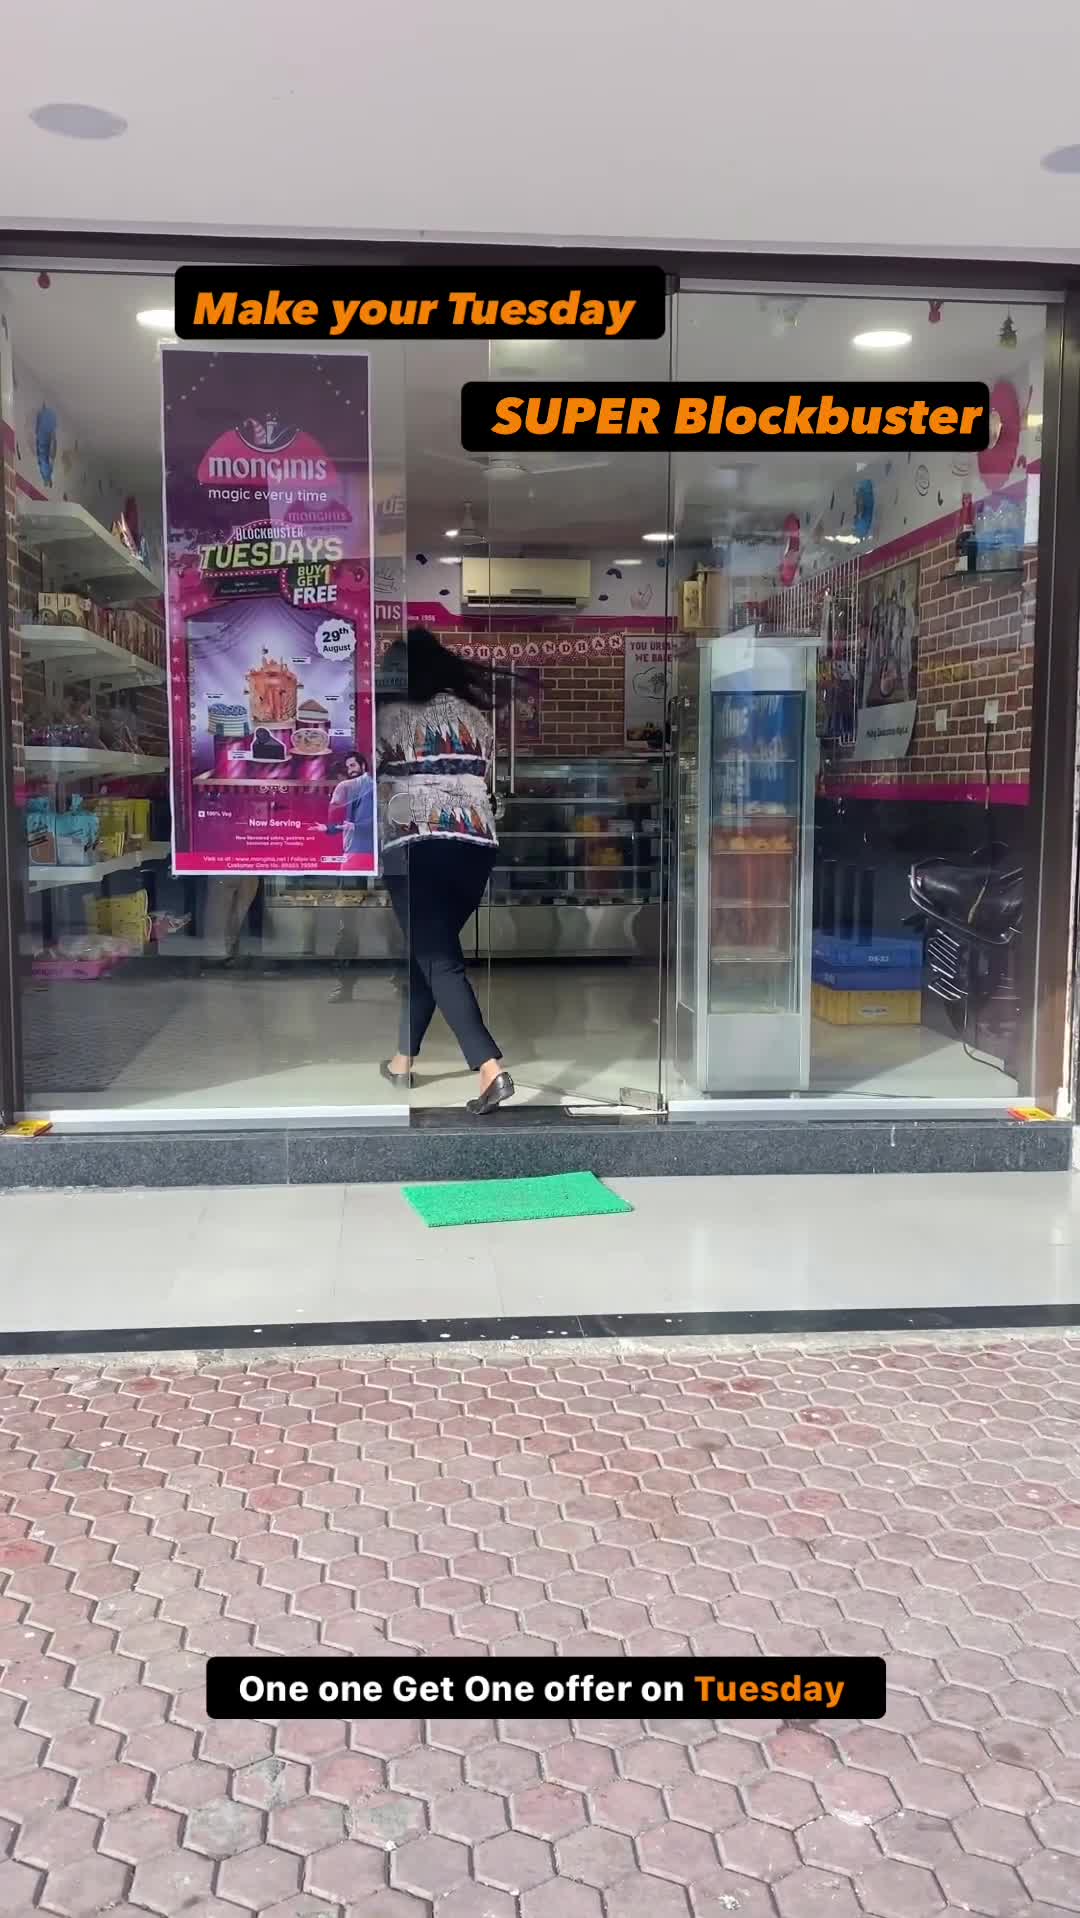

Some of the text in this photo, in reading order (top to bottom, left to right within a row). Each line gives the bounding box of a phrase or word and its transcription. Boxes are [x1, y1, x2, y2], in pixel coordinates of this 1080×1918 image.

[208, 488, 328, 503] magic every time
[236, 525, 304, 542] BLOCKBUSTER
[200, 537, 344, 570] TUESDAYS
[297, 564, 321, 577] BUY
[297, 575, 319, 587] GET
[293, 585, 338, 606] FREE
[322, 627, 349, 643] 29th
[322, 643, 351, 653] August
[249, 818, 302, 829] Now Serving
